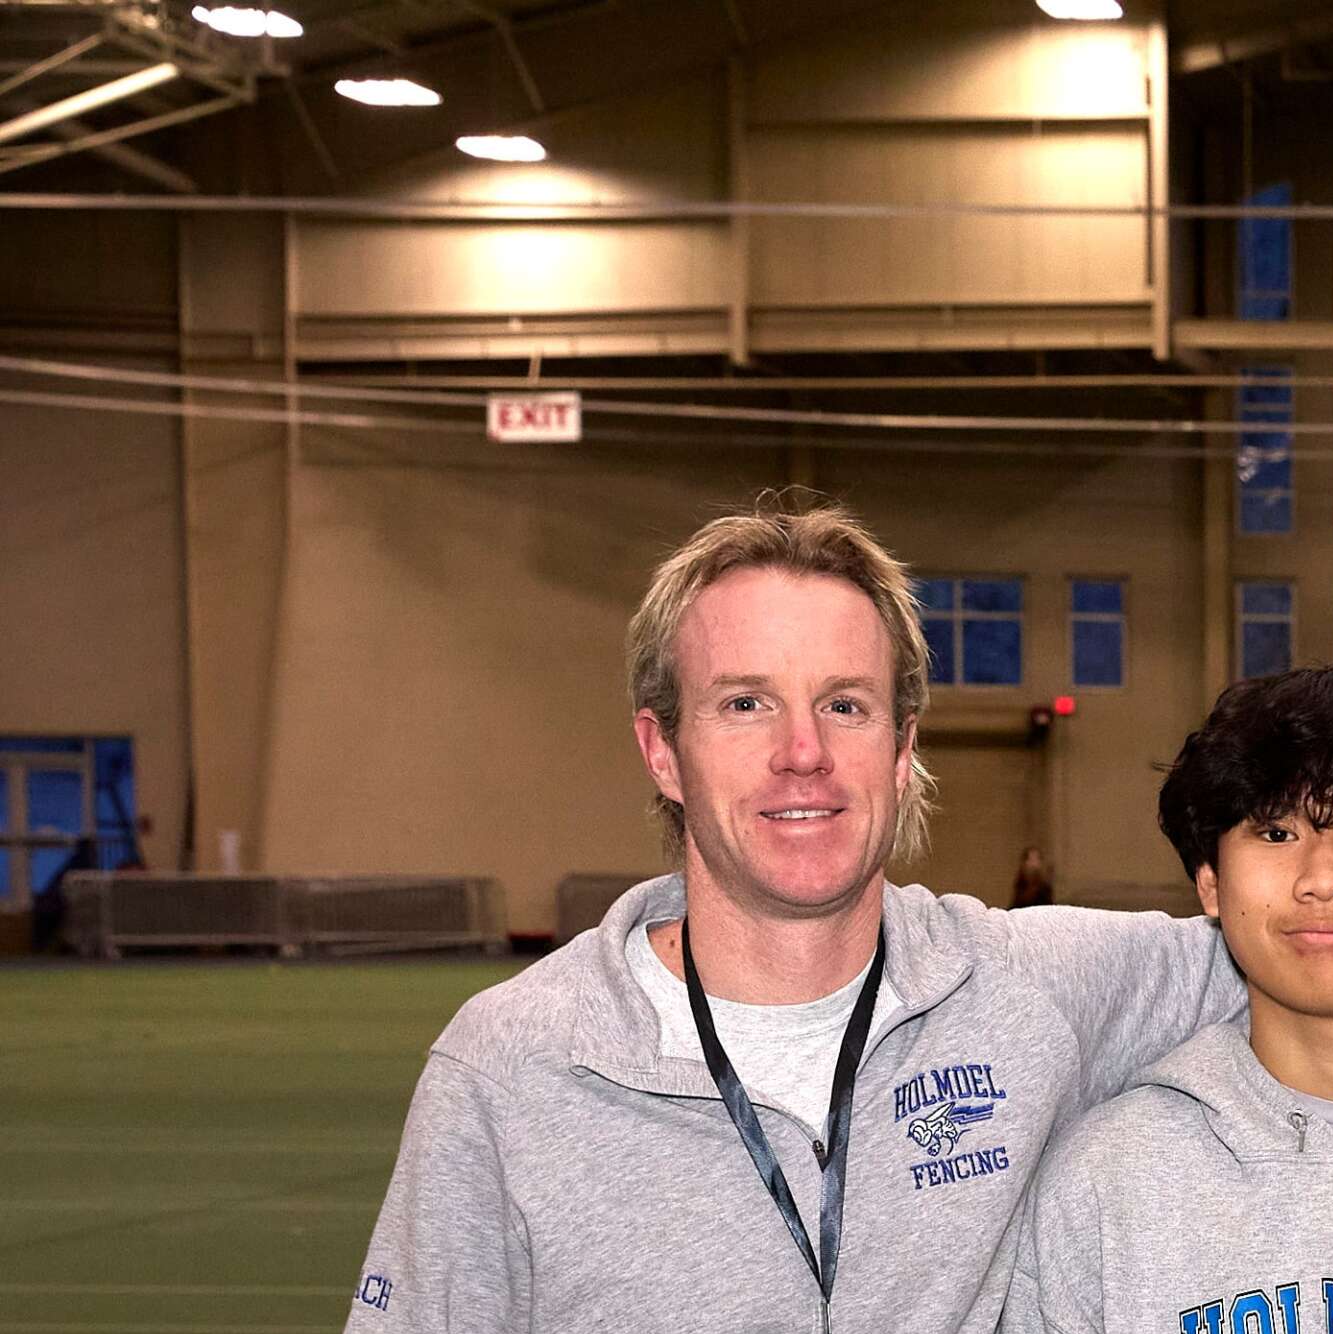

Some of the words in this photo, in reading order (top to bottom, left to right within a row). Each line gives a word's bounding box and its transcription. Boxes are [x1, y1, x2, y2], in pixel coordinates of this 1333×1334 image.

[499, 403, 569, 429] EXIT
[893, 1064, 1007, 1123] HOLMDEL
[910, 1147, 1010, 1190] FENCING
